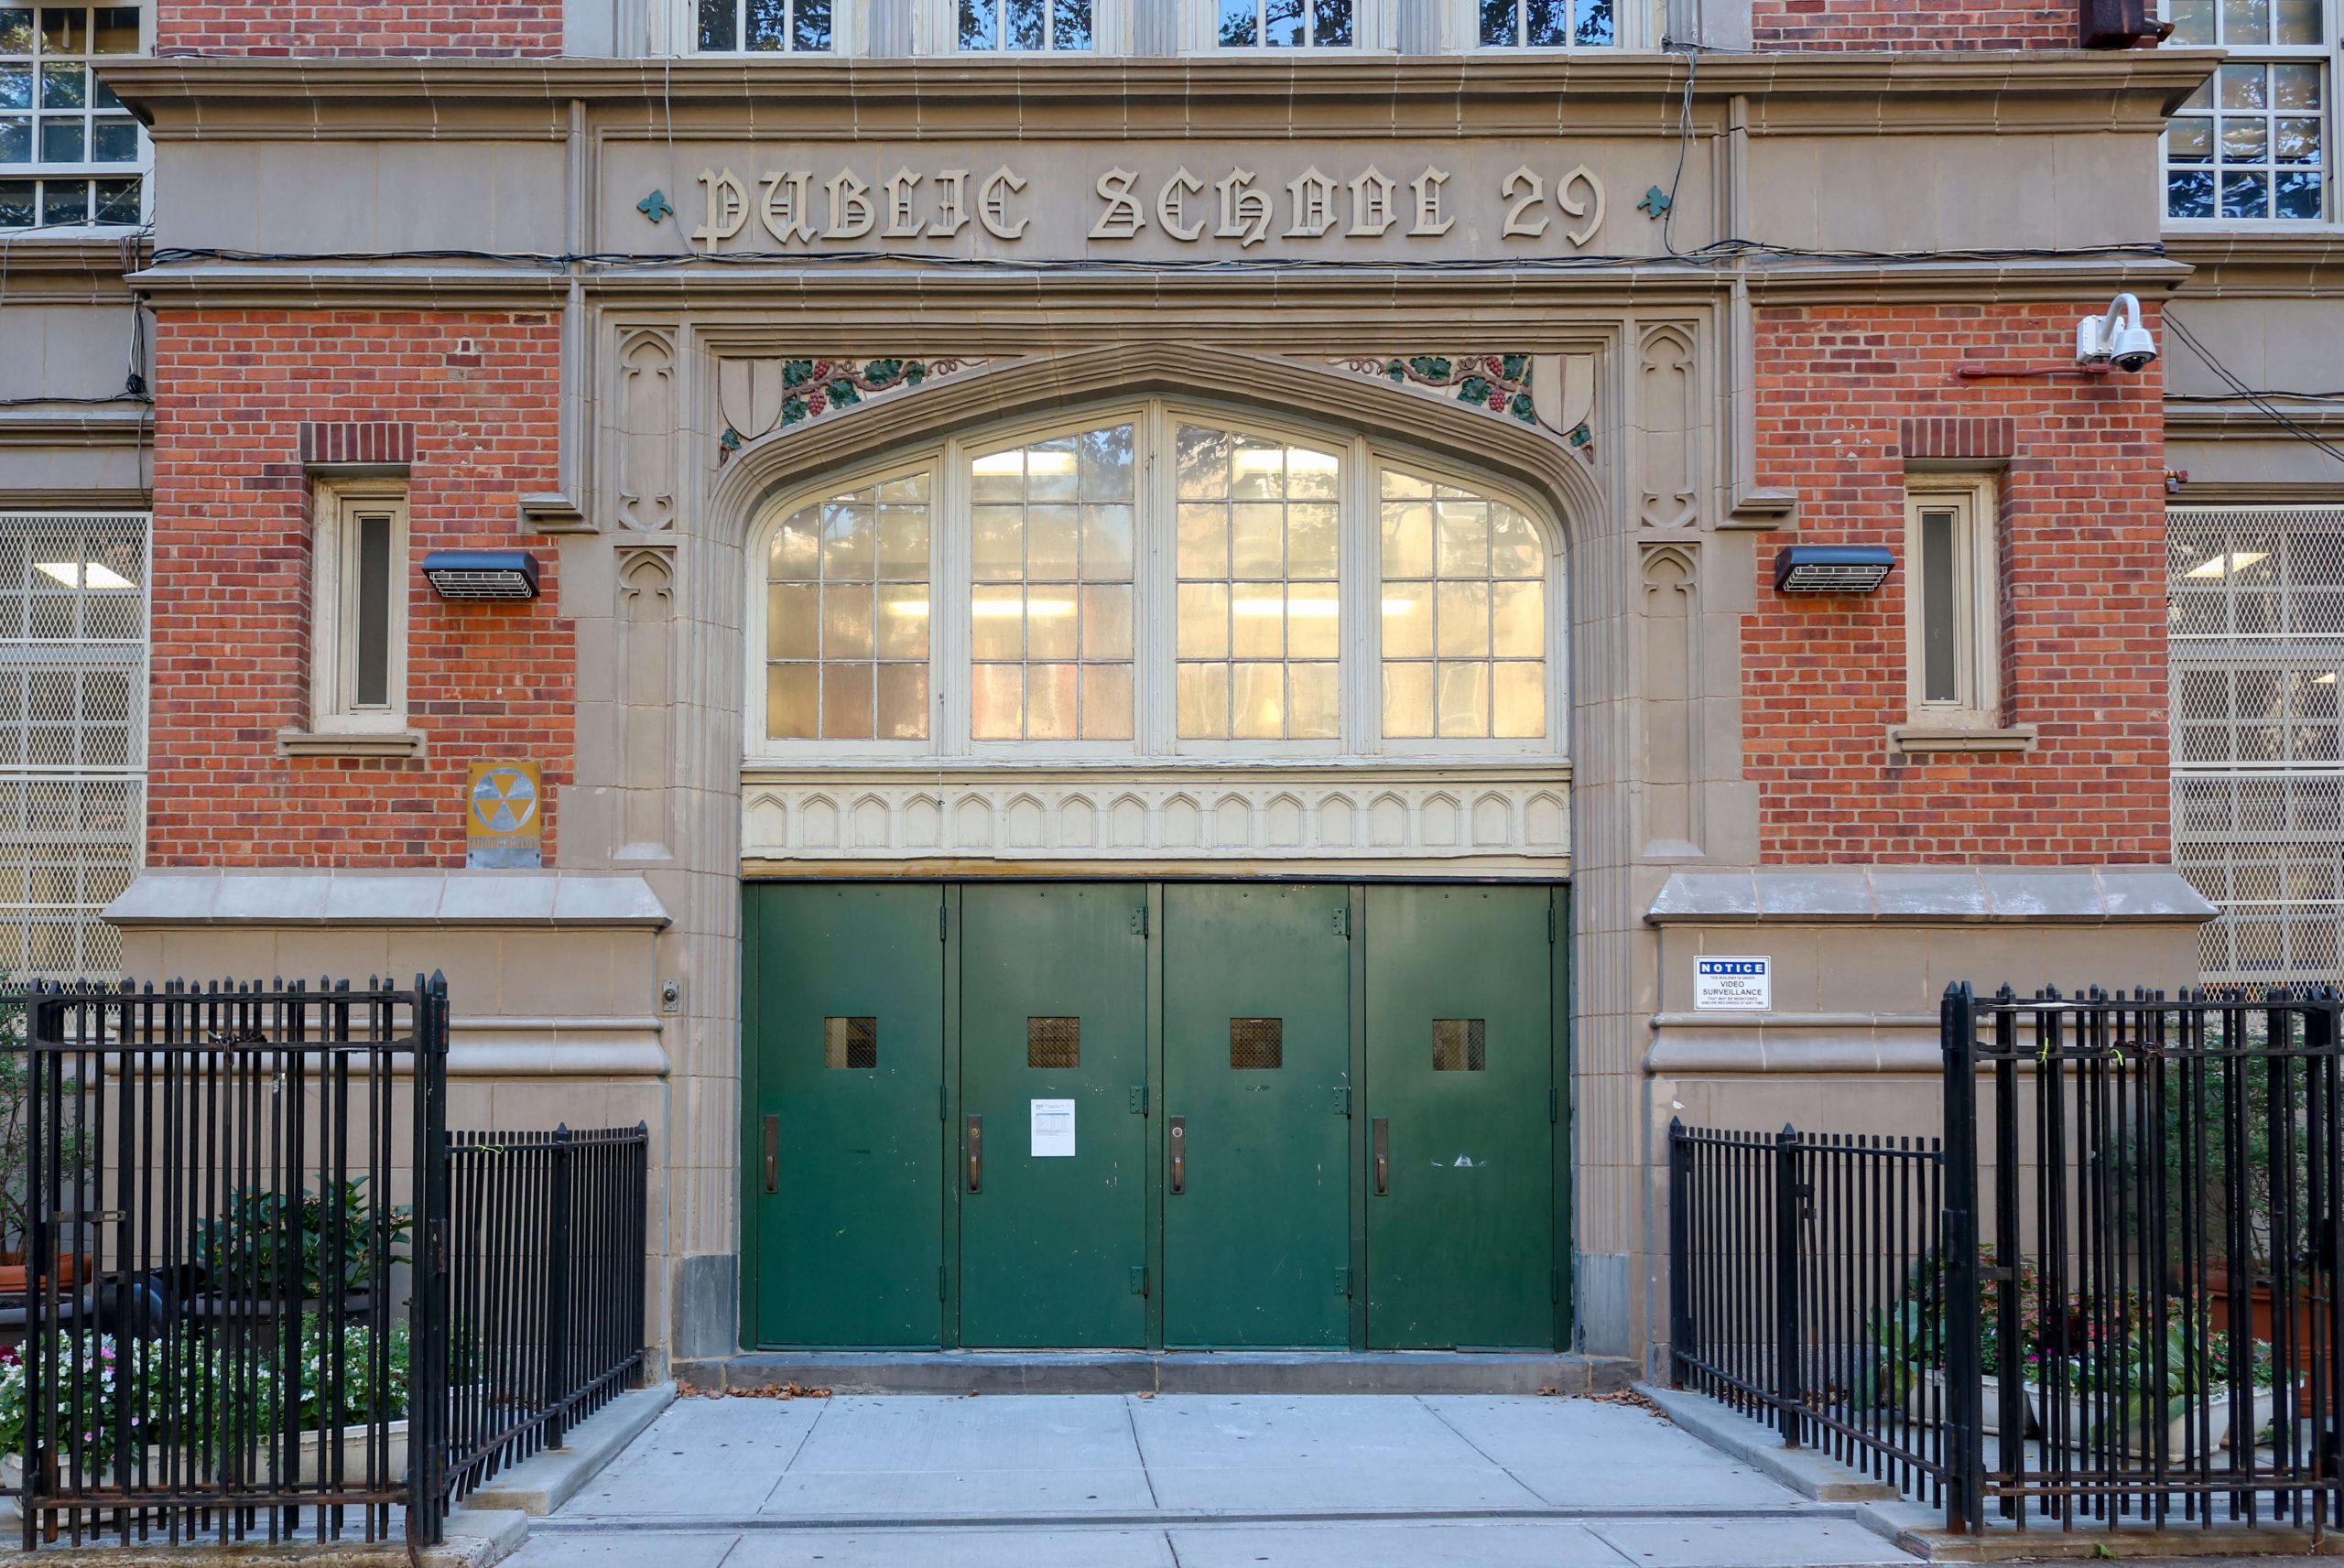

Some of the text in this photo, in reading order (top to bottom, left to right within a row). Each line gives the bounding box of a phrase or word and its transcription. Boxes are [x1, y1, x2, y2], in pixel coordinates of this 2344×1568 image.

[691, 164, 1606, 254] PUBLIC SCHOOL 29
[1701, 964, 1763, 973] NOTICE
